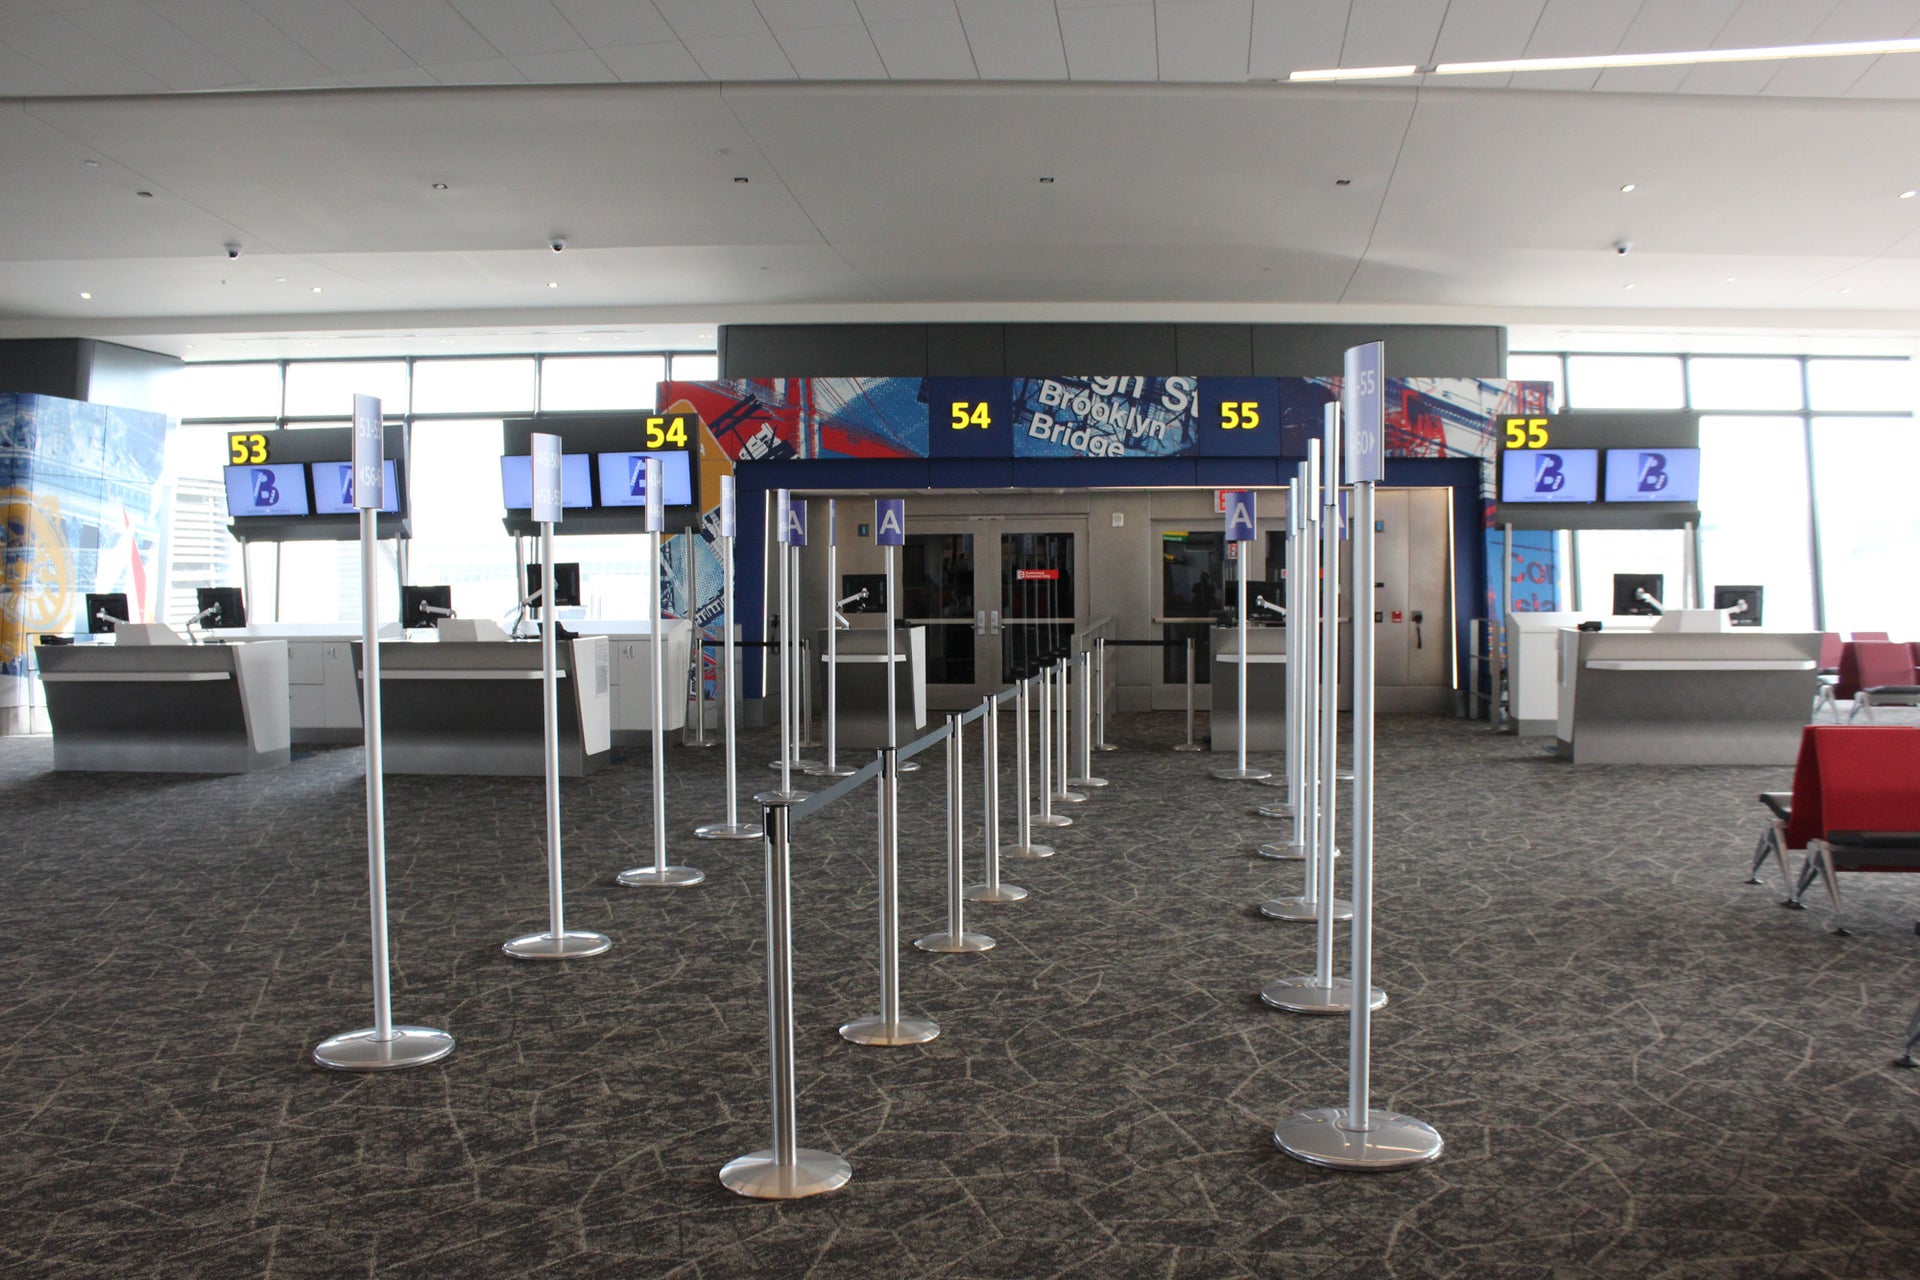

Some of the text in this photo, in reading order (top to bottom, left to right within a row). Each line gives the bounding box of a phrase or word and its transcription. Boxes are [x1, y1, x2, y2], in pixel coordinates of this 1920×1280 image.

[951, 402, 991, 429] 54
[1038, 379, 1166, 440] Brooklyn
[1221, 402, 1260, 429] 55
[646, 417, 688, 448] 54
[1028, 412, 1125, 457] Bridge
[1505, 418, 1549, 449] 55
[231, 434, 268, 465] 53
[788, 510, 803, 535] A
[879, 509, 901, 535] A
[1230, 502, 1253, 529] A
